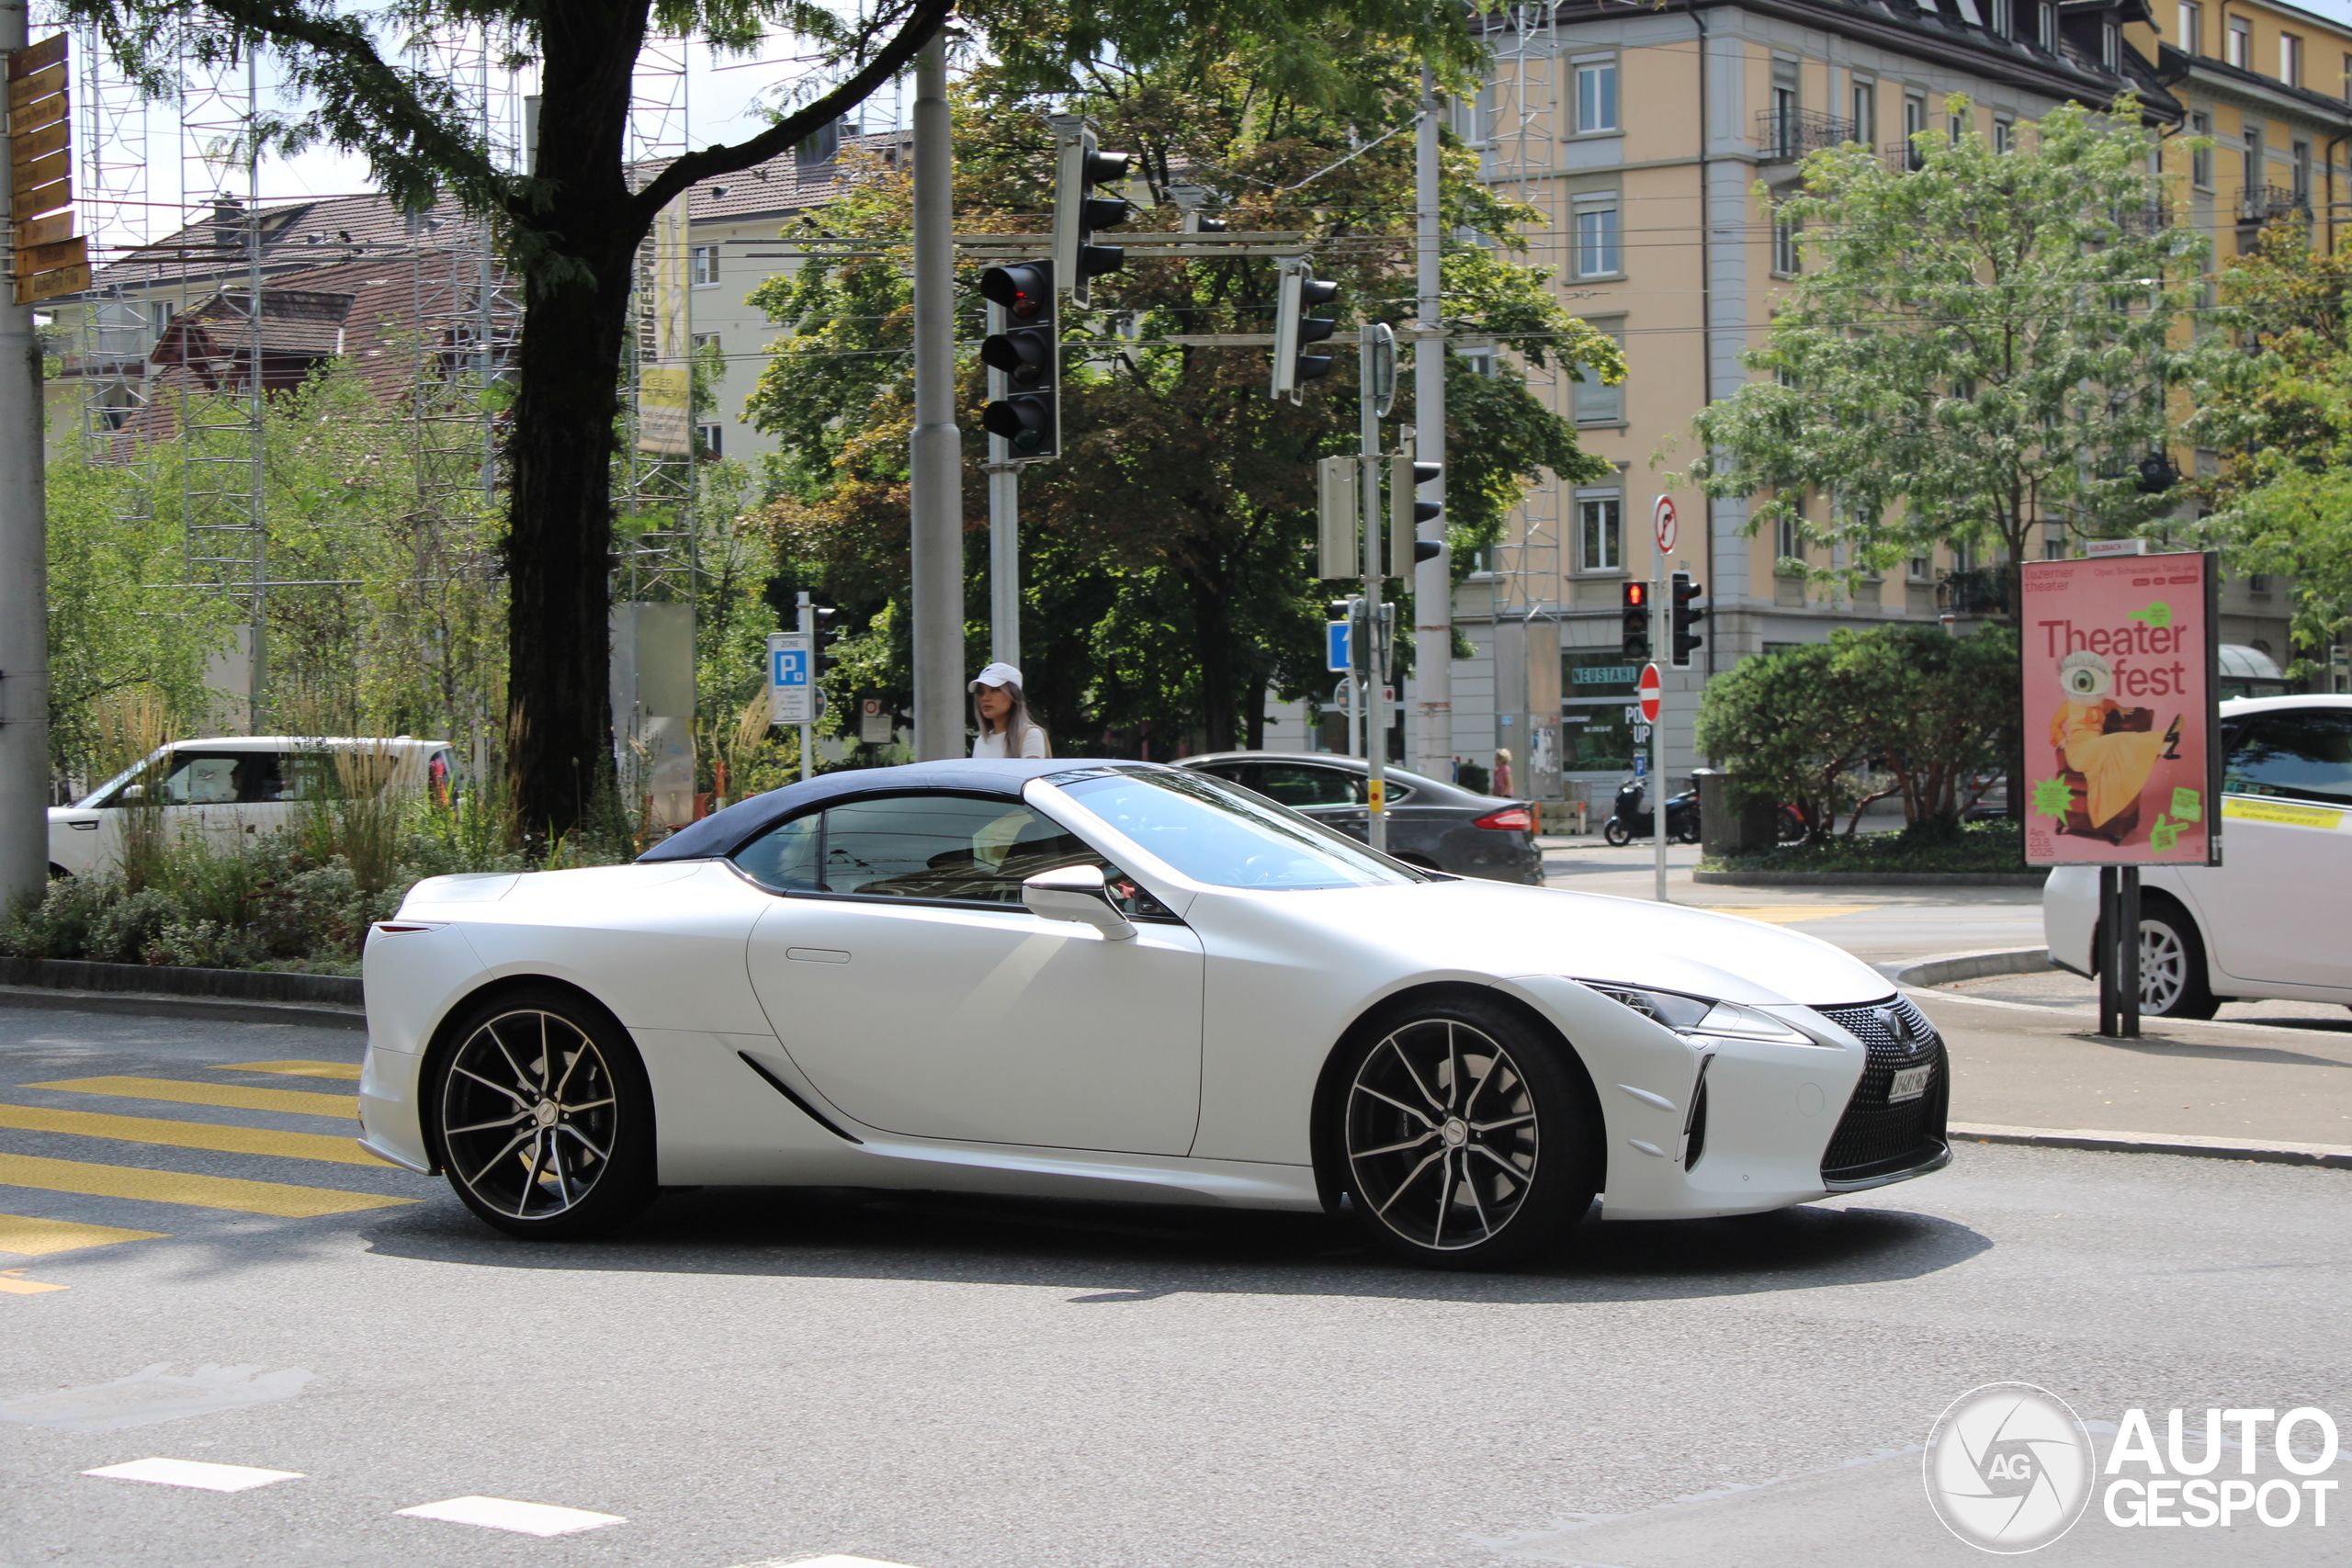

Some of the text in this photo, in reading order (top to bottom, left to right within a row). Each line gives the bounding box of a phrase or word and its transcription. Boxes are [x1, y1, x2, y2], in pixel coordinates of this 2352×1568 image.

[2025, 581, 2069, 592] theater
[2038, 619, 2188, 659] Theater
[780, 655, 797, 681] P
[1574, 667, 1635, 682] NEUSTAHL
[2111, 659, 2186, 696] fest
[1624, 706, 1645, 724] PO
[1634, 726, 1651, 743] UP
[2030, 828, 2045, 837] Am
[2030, 837, 2052, 847] 23.8.
[2030, 847, 2054, 857] 2025
